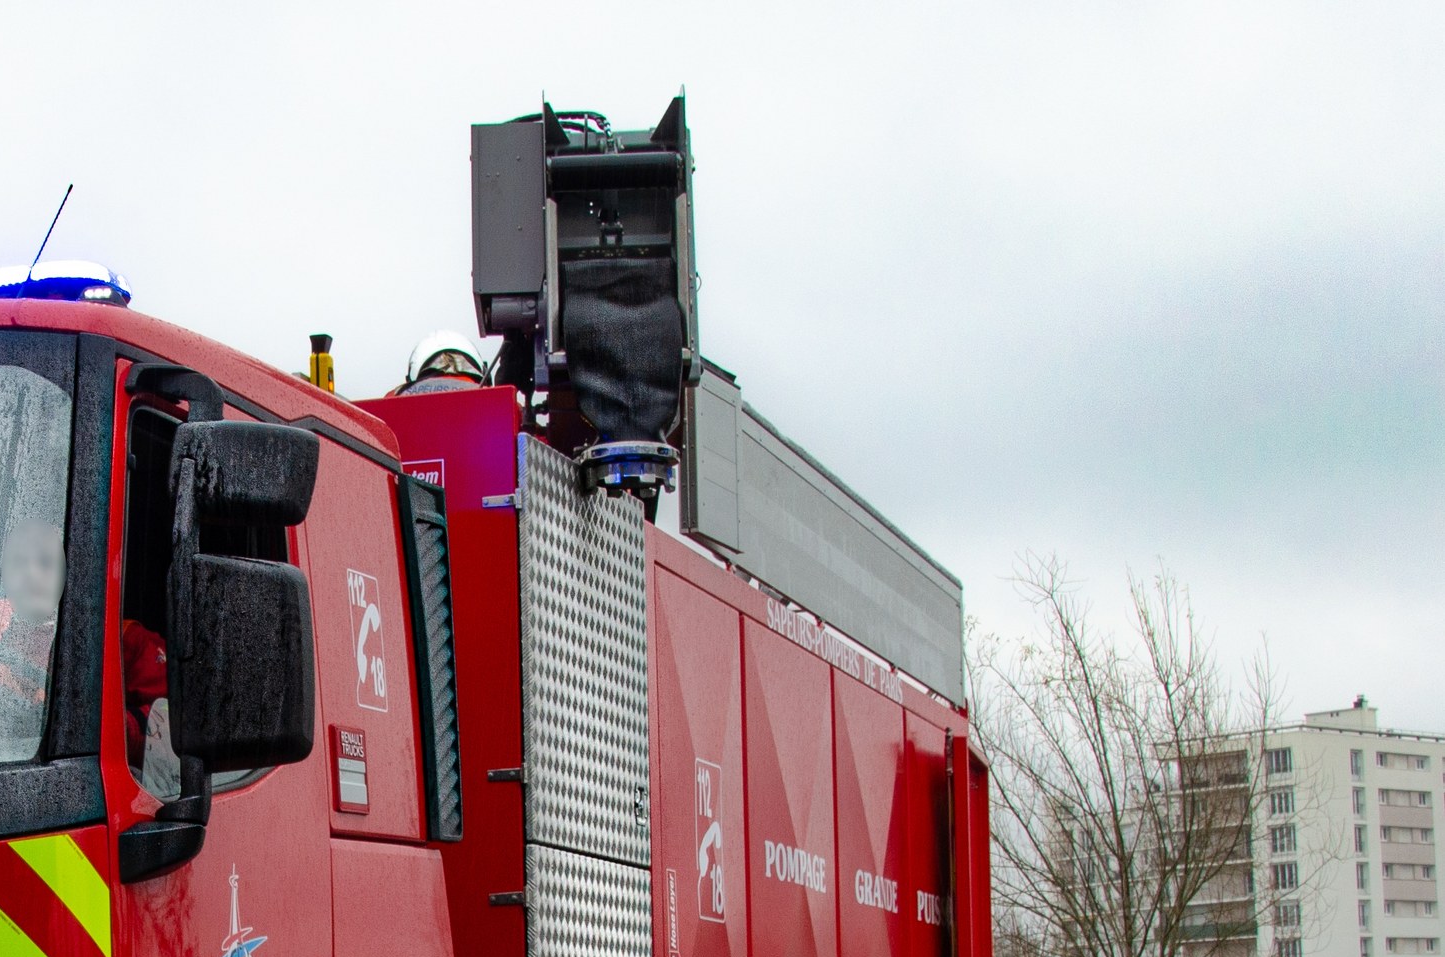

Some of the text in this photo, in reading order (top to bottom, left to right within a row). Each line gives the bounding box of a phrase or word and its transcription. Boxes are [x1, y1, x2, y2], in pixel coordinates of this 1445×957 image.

[348, 572, 367, 608] 112
[767, 598, 903, 704] SAPEURS-POMPIERS DE PARIS
[371, 656, 385, 698] 18
[341, 731, 363, 746] RENAULT
[342, 743, 364, 758] TRUCKS
[697, 767, 712, 818] 112
[710, 863, 724, 914] 18
[765, 840, 826, 893] POMPAGE
[855, 869, 898, 914] GRANDE
